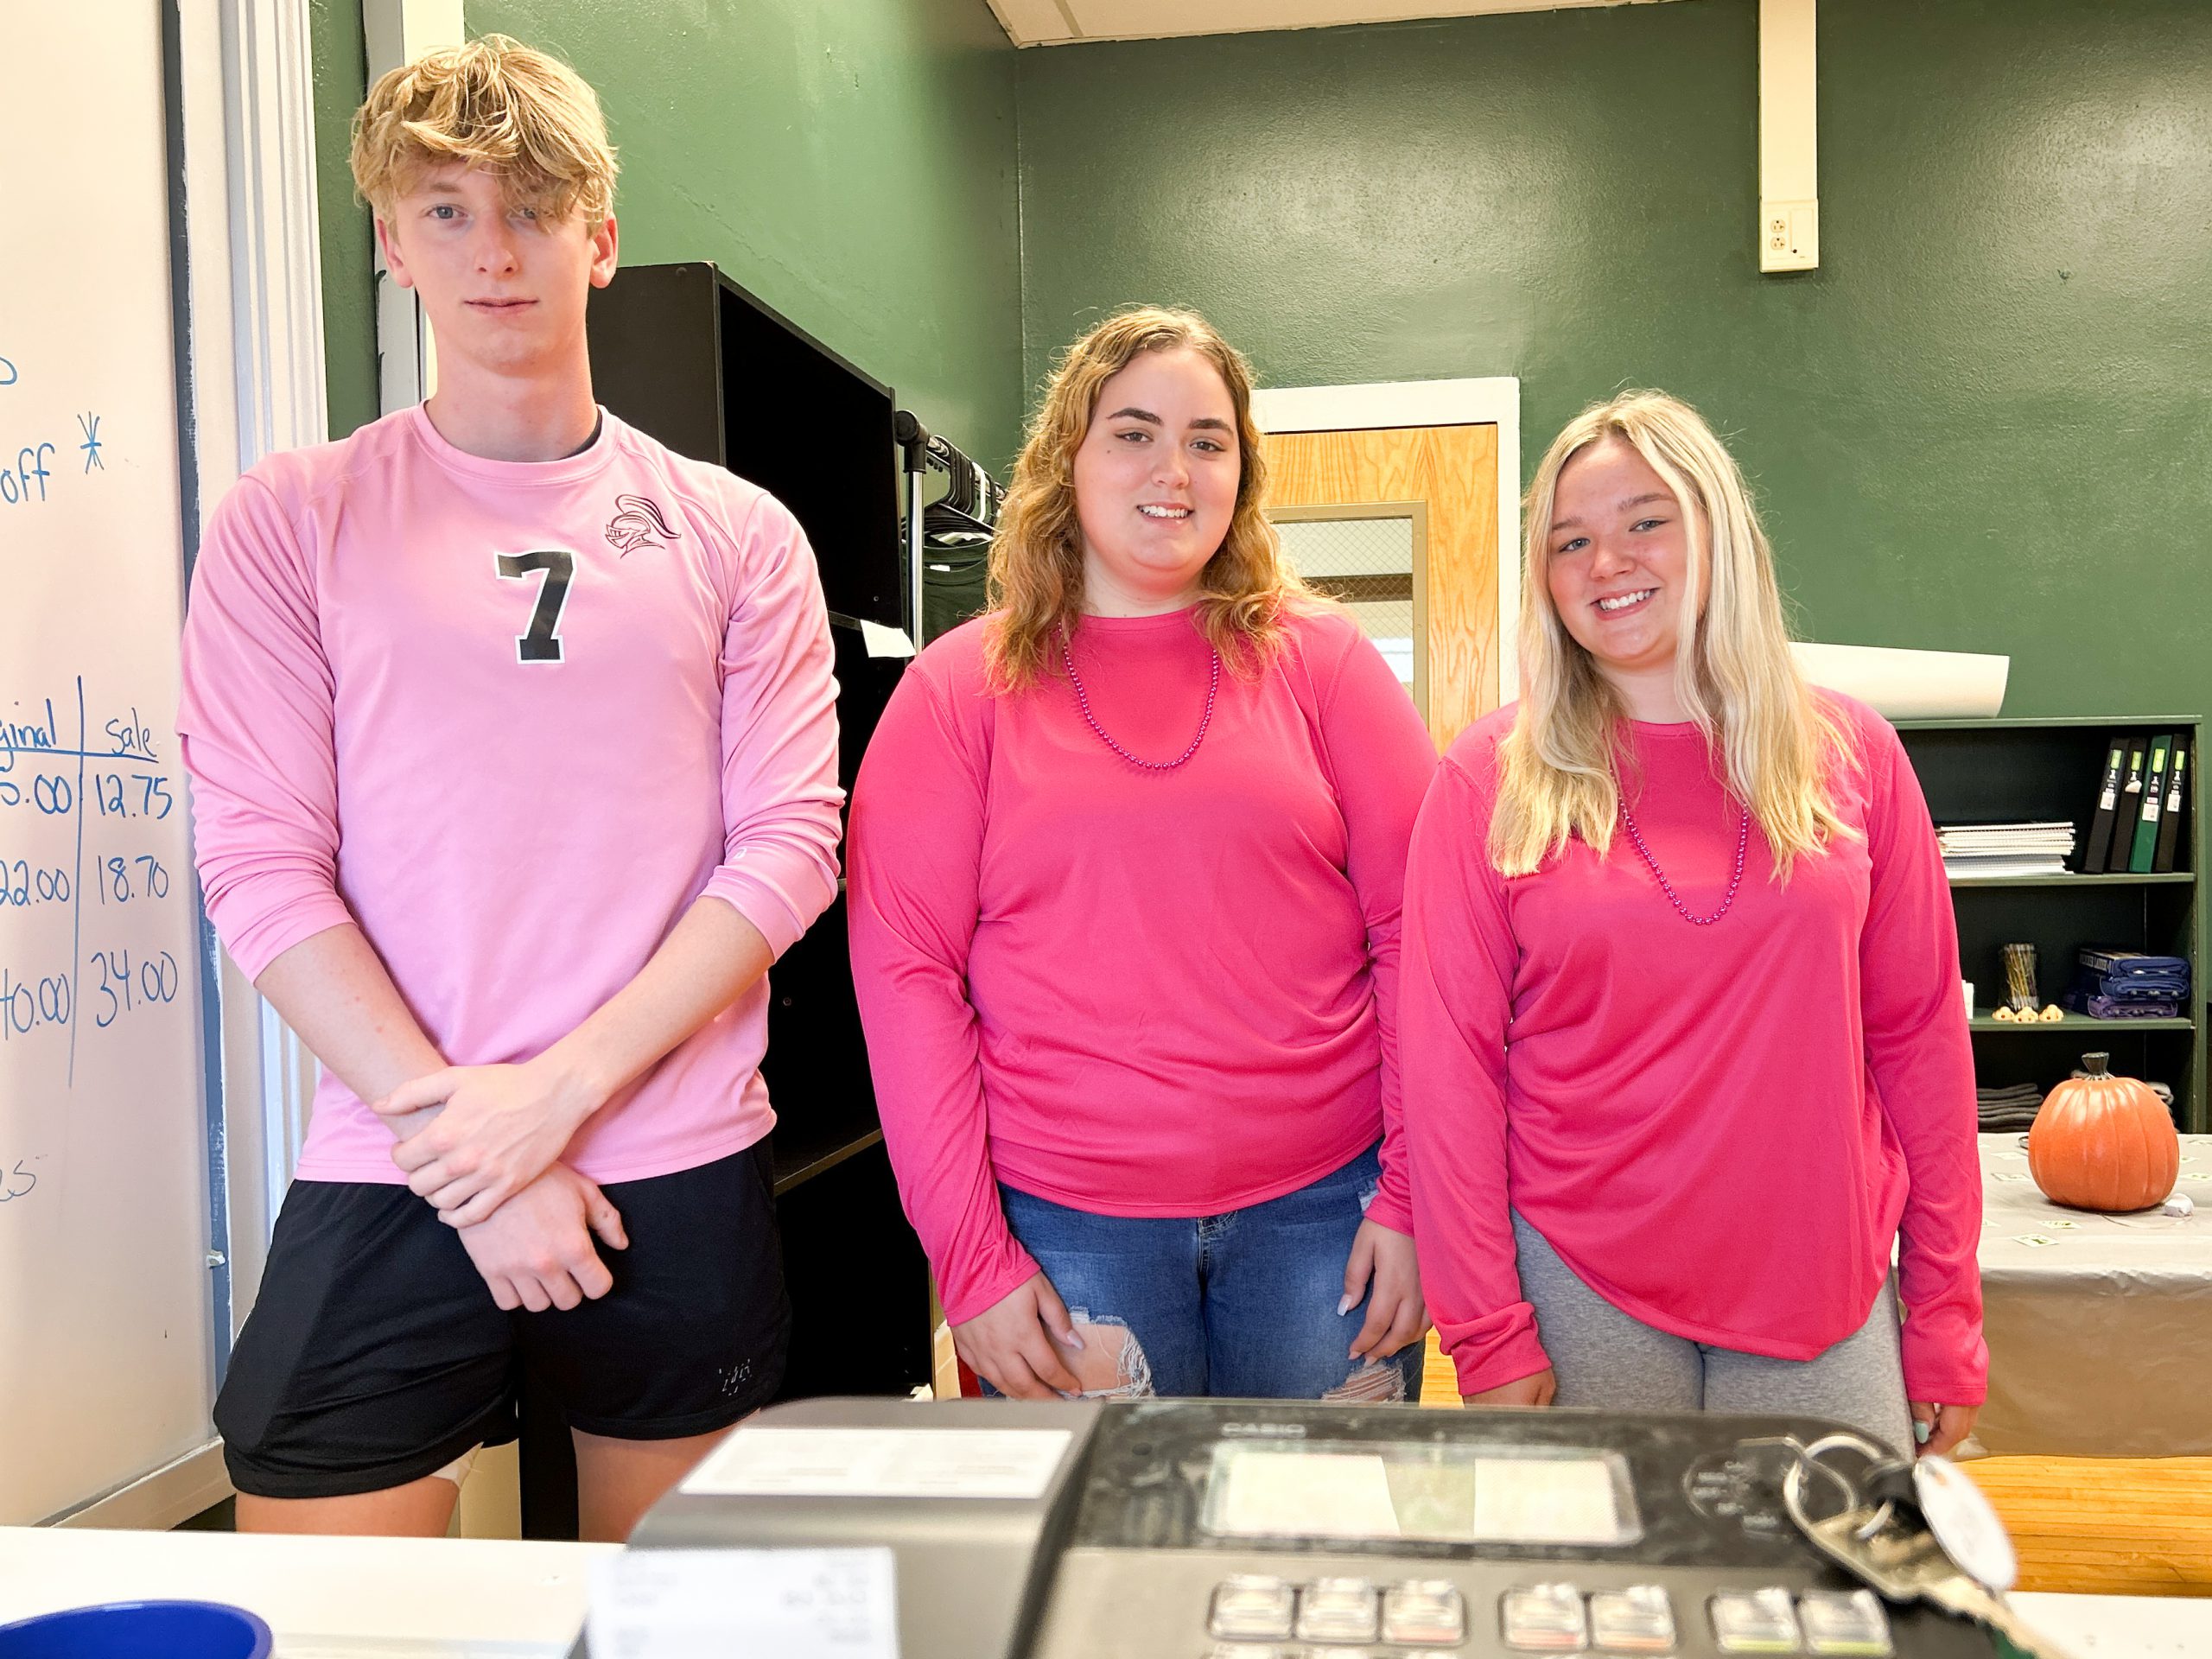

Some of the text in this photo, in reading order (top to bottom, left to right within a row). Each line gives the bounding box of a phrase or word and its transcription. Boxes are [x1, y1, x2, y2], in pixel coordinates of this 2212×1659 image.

[1, 442, 55, 504] off
[495, 549, 576, 663] 7
[105, 707, 157, 755] Sale
[95, 774, 173, 820] 12.75
[98, 855, 169, 905] 18.70
[91, 949, 178, 1027] 34.00
